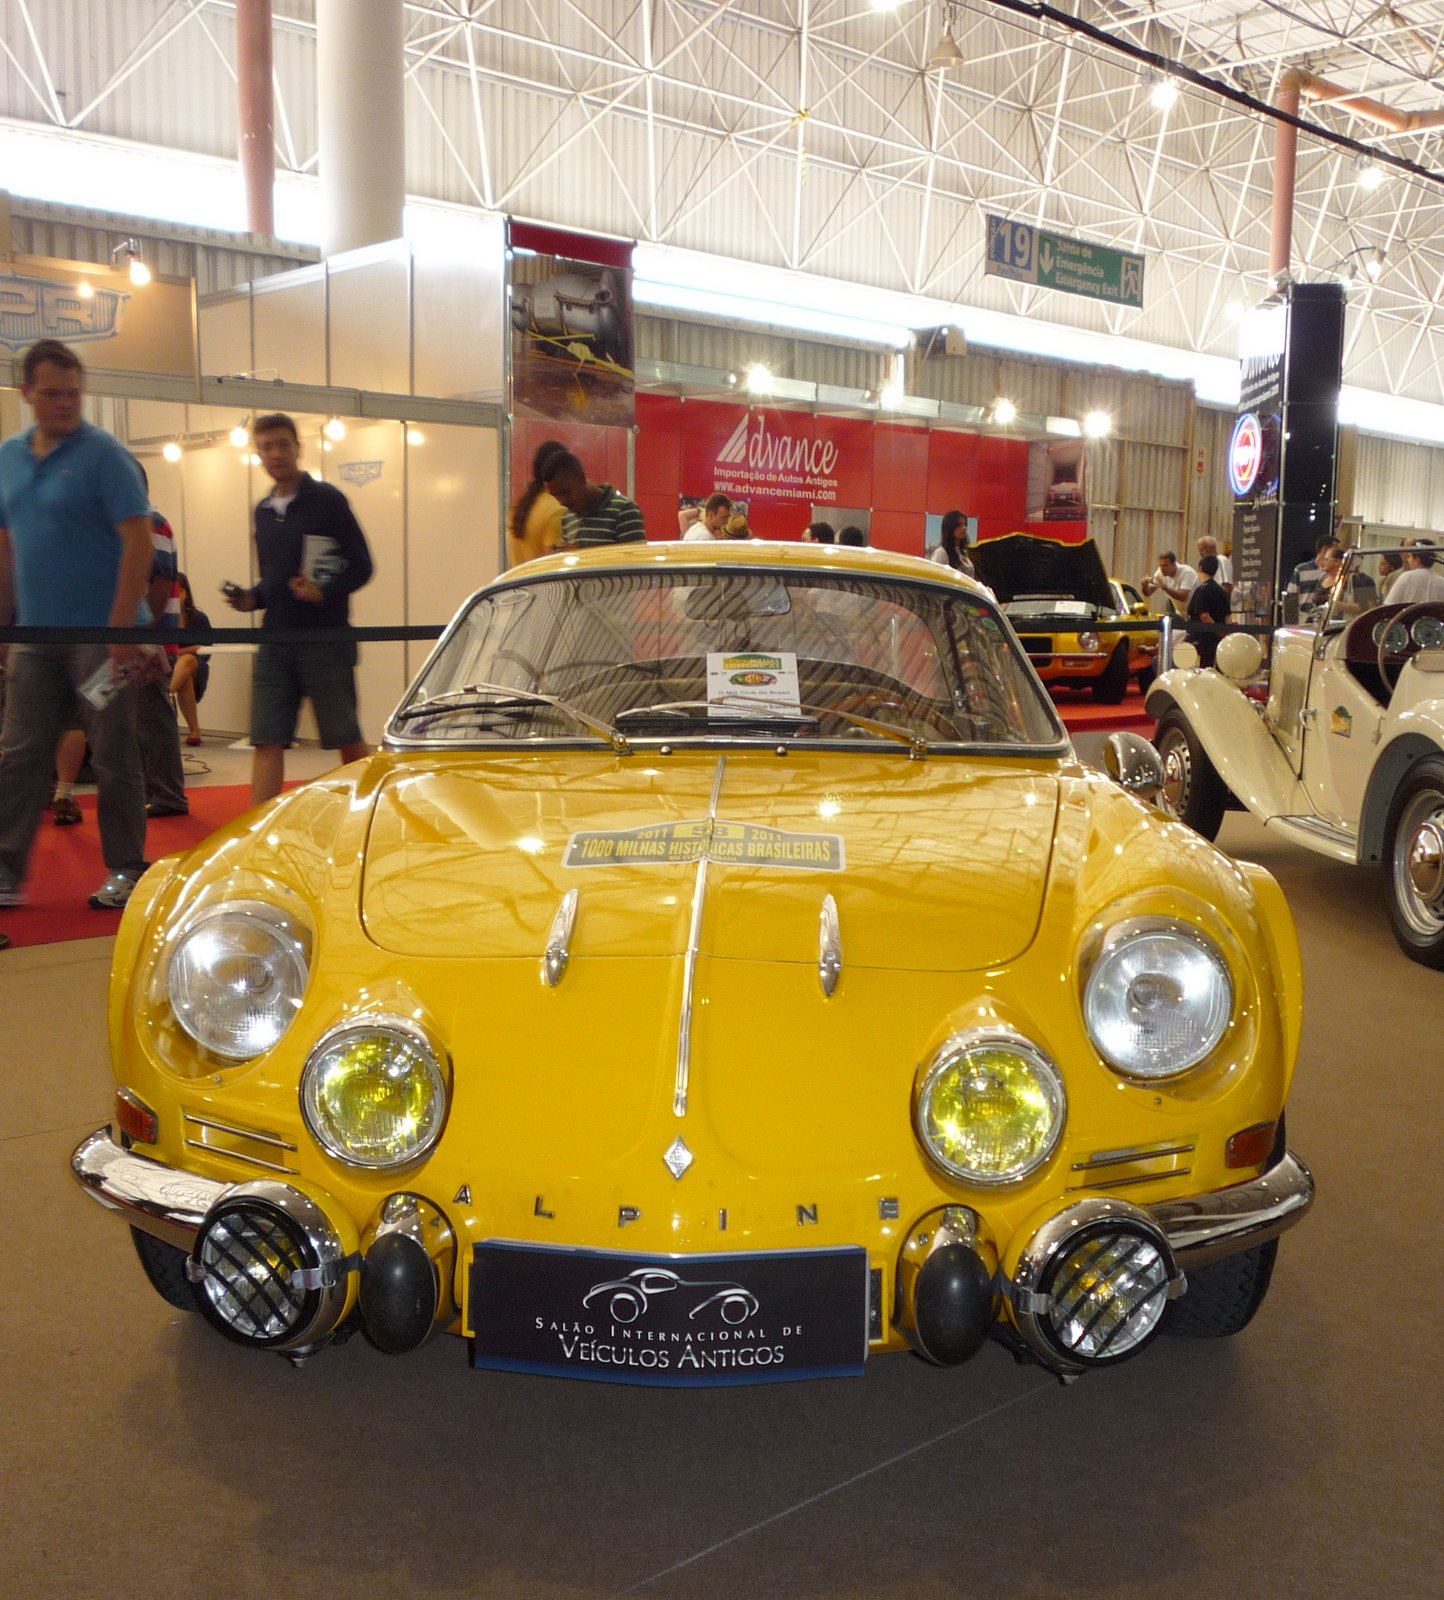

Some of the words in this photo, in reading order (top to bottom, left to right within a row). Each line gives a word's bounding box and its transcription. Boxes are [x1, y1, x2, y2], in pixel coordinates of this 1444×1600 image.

[1000, 223, 1030, 267] 19
[1056, 272, 1101, 296] Emergency
[1103, 283, 1118, 297] Exit
[714, 466, 765, 482] Importação
[766, 472, 778, 481] de
[778, 473, 803, 484] Autos
[805, 476, 838, 488] Antigos
[714, 480, 836, 500] www.advancemiami.com
[637, 827, 668, 839] 2011
[752, 829, 782, 841] 2011
[581, 838, 614, 858] 1000
[616, 840, 666, 857] MILHAS
[747, 841, 831, 861] BRASILEIRAS
[453, 1184, 899, 1231] ALPINE
[783, 1325, 802, 1336] DE
